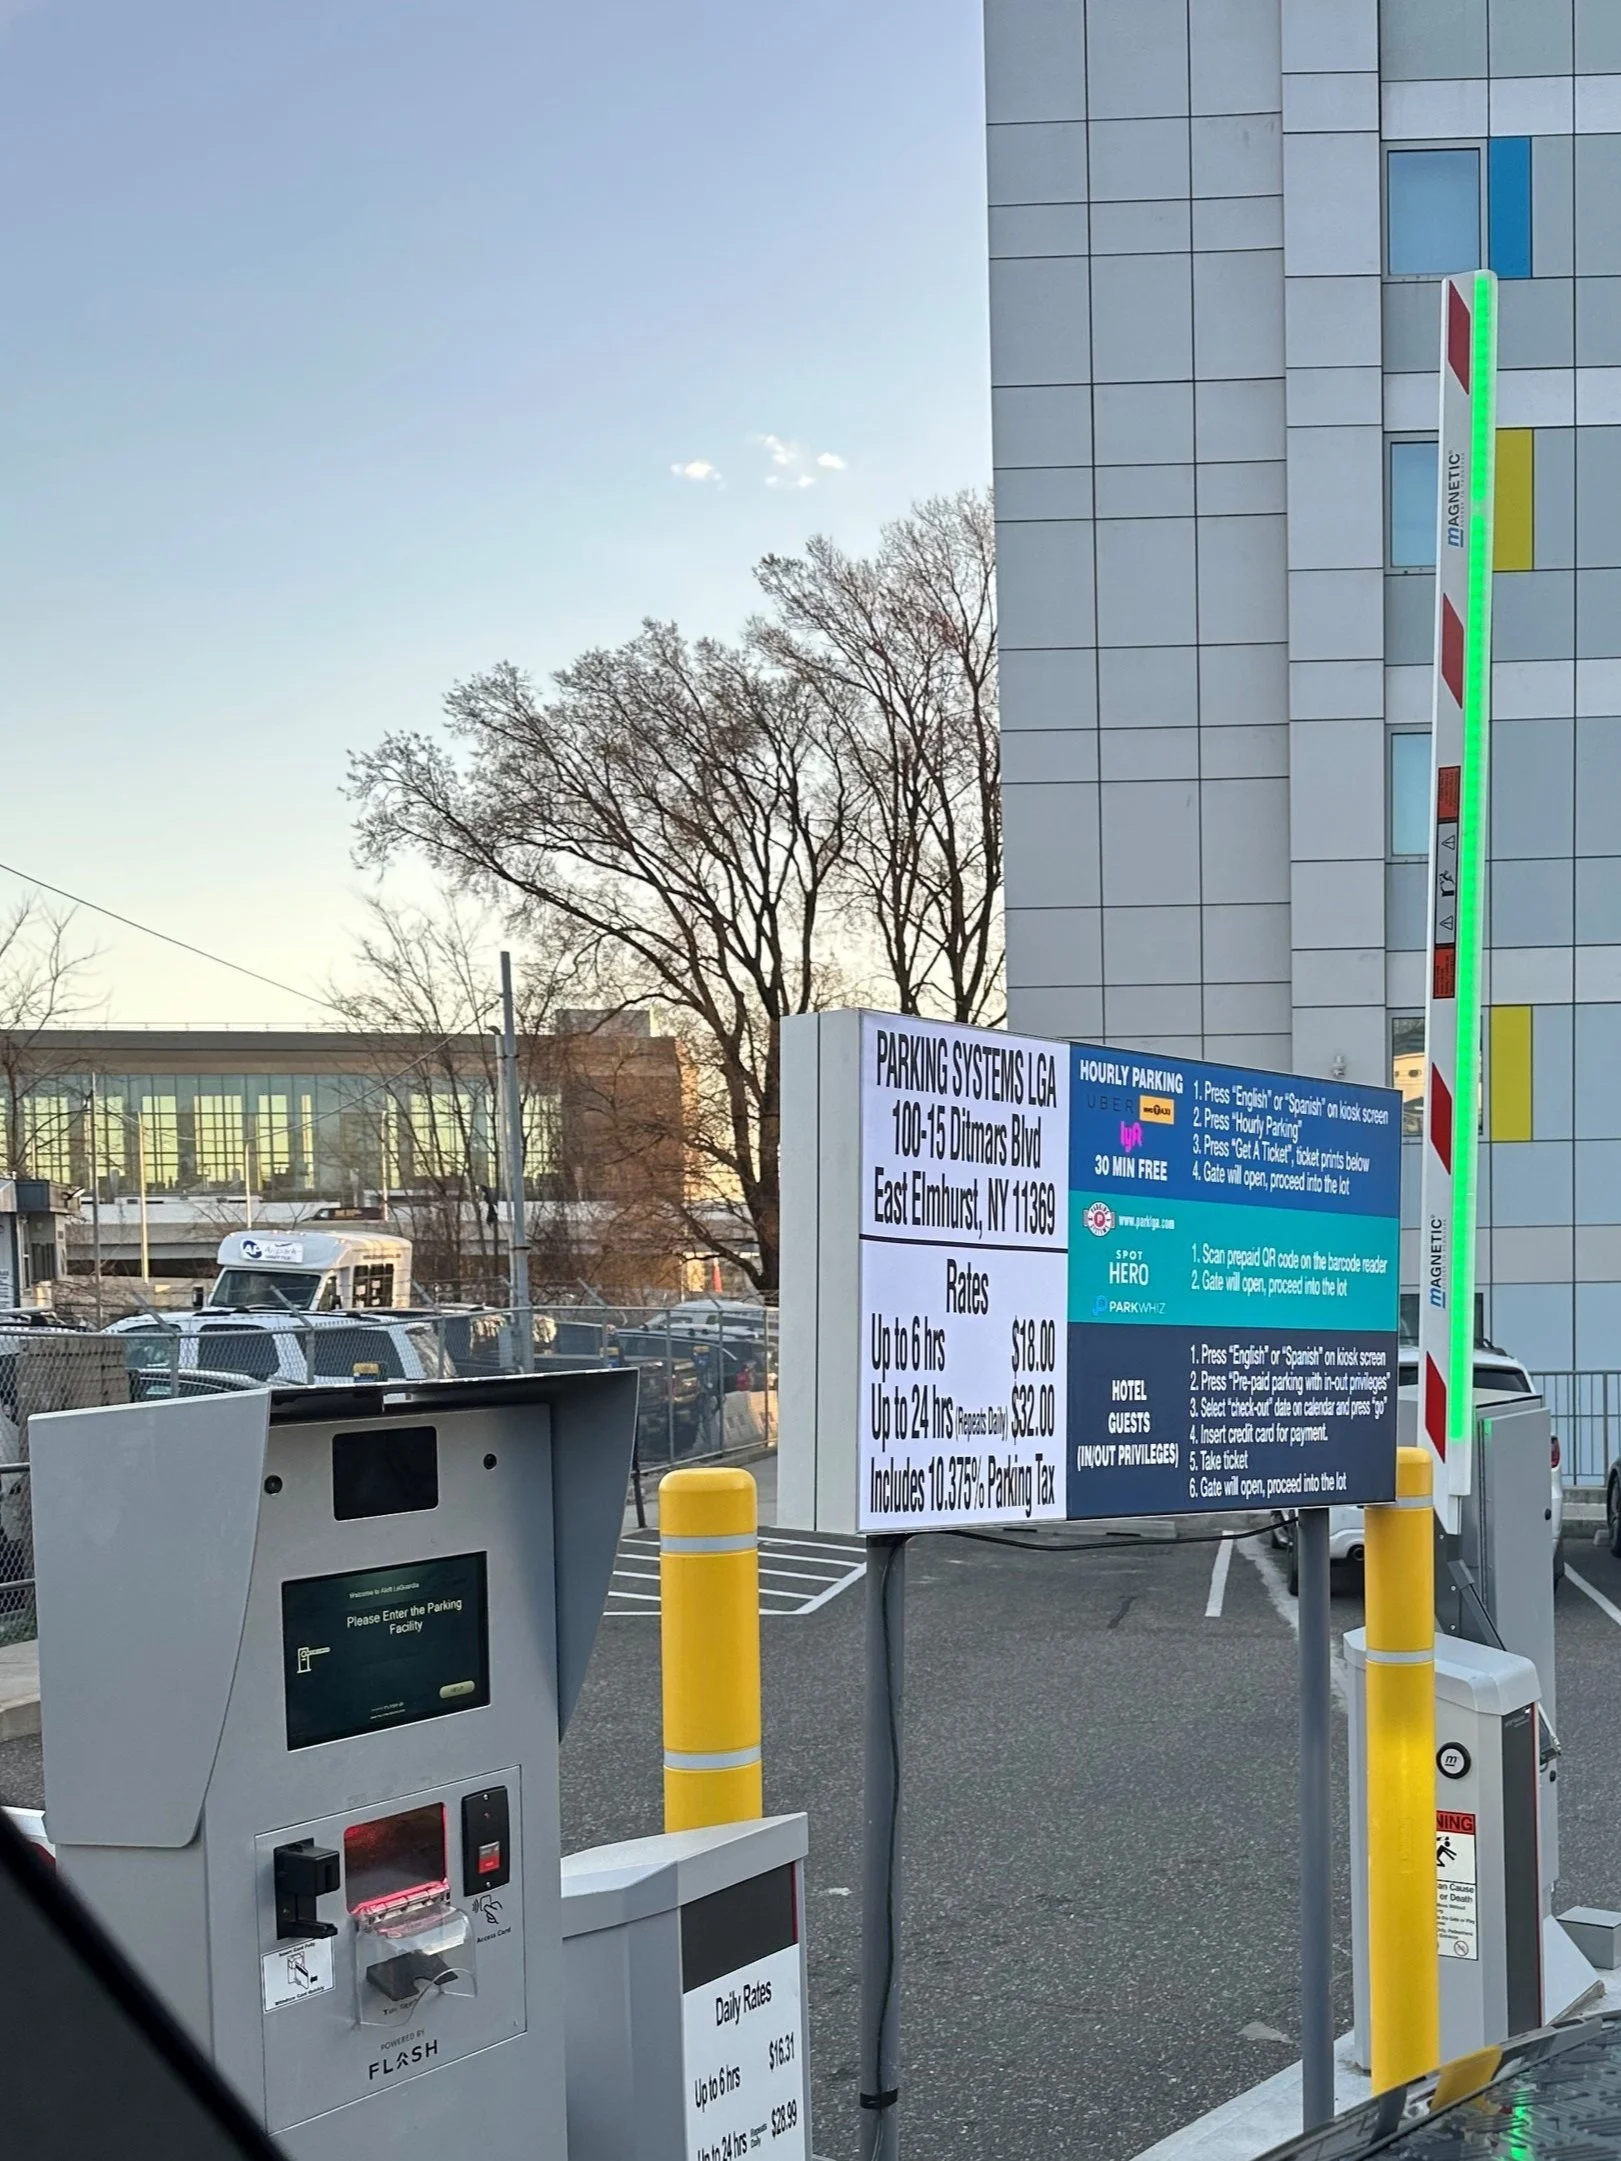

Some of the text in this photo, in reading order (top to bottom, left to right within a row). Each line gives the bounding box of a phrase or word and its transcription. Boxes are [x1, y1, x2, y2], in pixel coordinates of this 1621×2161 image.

[877, 1029, 1057, 1108] PARKING SYSTEMS LGA
[1080, 1059, 1184, 1094] HOURLY PARKING
[1087, 1094, 1134, 1114] UBER
[1193, 1080, 1202, 1101] 1.
[1204, 1080, 1230, 1104] Press
[1274, 1094, 1283, 1111] or
[1327, 1103, 1338, 1118] on
[1340, 1101, 1361, 1122] kiosk
[1362, 1108, 1389, 1125] screen
[892, 1100, 1042, 1169] 100-15 Ditmars Blvd
[1193, 1107, 1202, 1128] 2.
[1204, 1108, 1230, 1131] Press
[1095, 1155, 1168, 1181] 30 MIN FREE
[1192, 1134, 1201, 1155] 3.
[1204, 1135, 1229, 1158] Press
[1253, 1141, 1260, 1161] A
[1296, 1145, 1320, 1167] ticket
[1321, 1151, 1344, 1172] prints
[1345, 1151, 1370, 1173] below
[1192, 1161, 1350, 1196] 4. Gate will open, proceed into the lot
[874, 1166, 1055, 1240] East Elmhurst, NY 11369
[1116, 1250, 1143, 1260] SPOT
[1191, 1243, 1388, 1274] 1. Scan prepaid QR code on the barcode reader
[946, 1258, 989, 1315] Rates
[1109, 1261, 1149, 1286] HERO
[1191, 1270, 1348, 1297] 2. Gate will open, proceed into the lot
[1109, 1300, 1167, 1315] PARKWHIZ
[871, 1313, 945, 1383] Up to 6 hrs
[1012, 1315, 1055, 1379] $18.00
[1190, 1345, 1199, 1364] 1.
[1201, 1344, 1227, 1365] Press
[1270, 1350, 1280, 1365] or
[1324, 1351, 1335, 1365] on
[1337, 1347, 1358, 1366] kiosk
[1359, 1351, 1386, 1367] screen
[1111, 1379, 1147, 1402] HOTEL
[1190, 1371, 1199, 1391] 2.
[1201, 1371, 1226, 1391] Press
[1272, 1372, 1304, 1395] parking
[1305, 1372, 1323, 1391] with
[1324, 1373, 1348, 1391] in-out
[871, 1383, 890, 1452] Up
[895, 1386, 908, 1440] to
[911, 1384, 929, 1439] 24
[933, 1384, 954, 1440] hrs
[1011, 1381, 1055, 1445] $32.00
[1108, 1411, 1151, 1434] GUESTS
[1190, 1397, 1198, 1417] 3.
[1200, 1397, 1226, 1418] Select
[1274, 1398, 1291, 1417] date
[1292, 1401, 1302, 1416] on
[1304, 1397, 1334, 1416] calendar
[1336, 1397, 1350, 1416] and
[1351, 1400, 1370, 1420] press
[1190, 1423, 1328, 1447] 4. Insert credit card for payment.
[1077, 1443, 1179, 1470] (IN/OUT PRIVILEGES)
[1189, 1450, 1248, 1471] 5. Take ticket
[870, 1453, 1055, 1518] Includes 10.375% Parking Tax
[1189, 1471, 1347, 1499] 6. Gate will open, proceed into the lot
[347, 1599, 462, 1628] Please Enter the Parking
[389, 1620, 423, 1635] Facility
[715, 1980, 772, 2026] Daily Rates
[381, 2028, 425, 2050] POWERED BY
[769, 2032, 795, 2072] $16.31
[368, 2039, 438, 2080] FLASH
[694, 2064, 741, 2113] Up to 6 hrs
[771, 2098, 797, 2140] $28.99
[722, 2132, 732, 2161] 24
[733, 2130, 747, 2158] hrs
